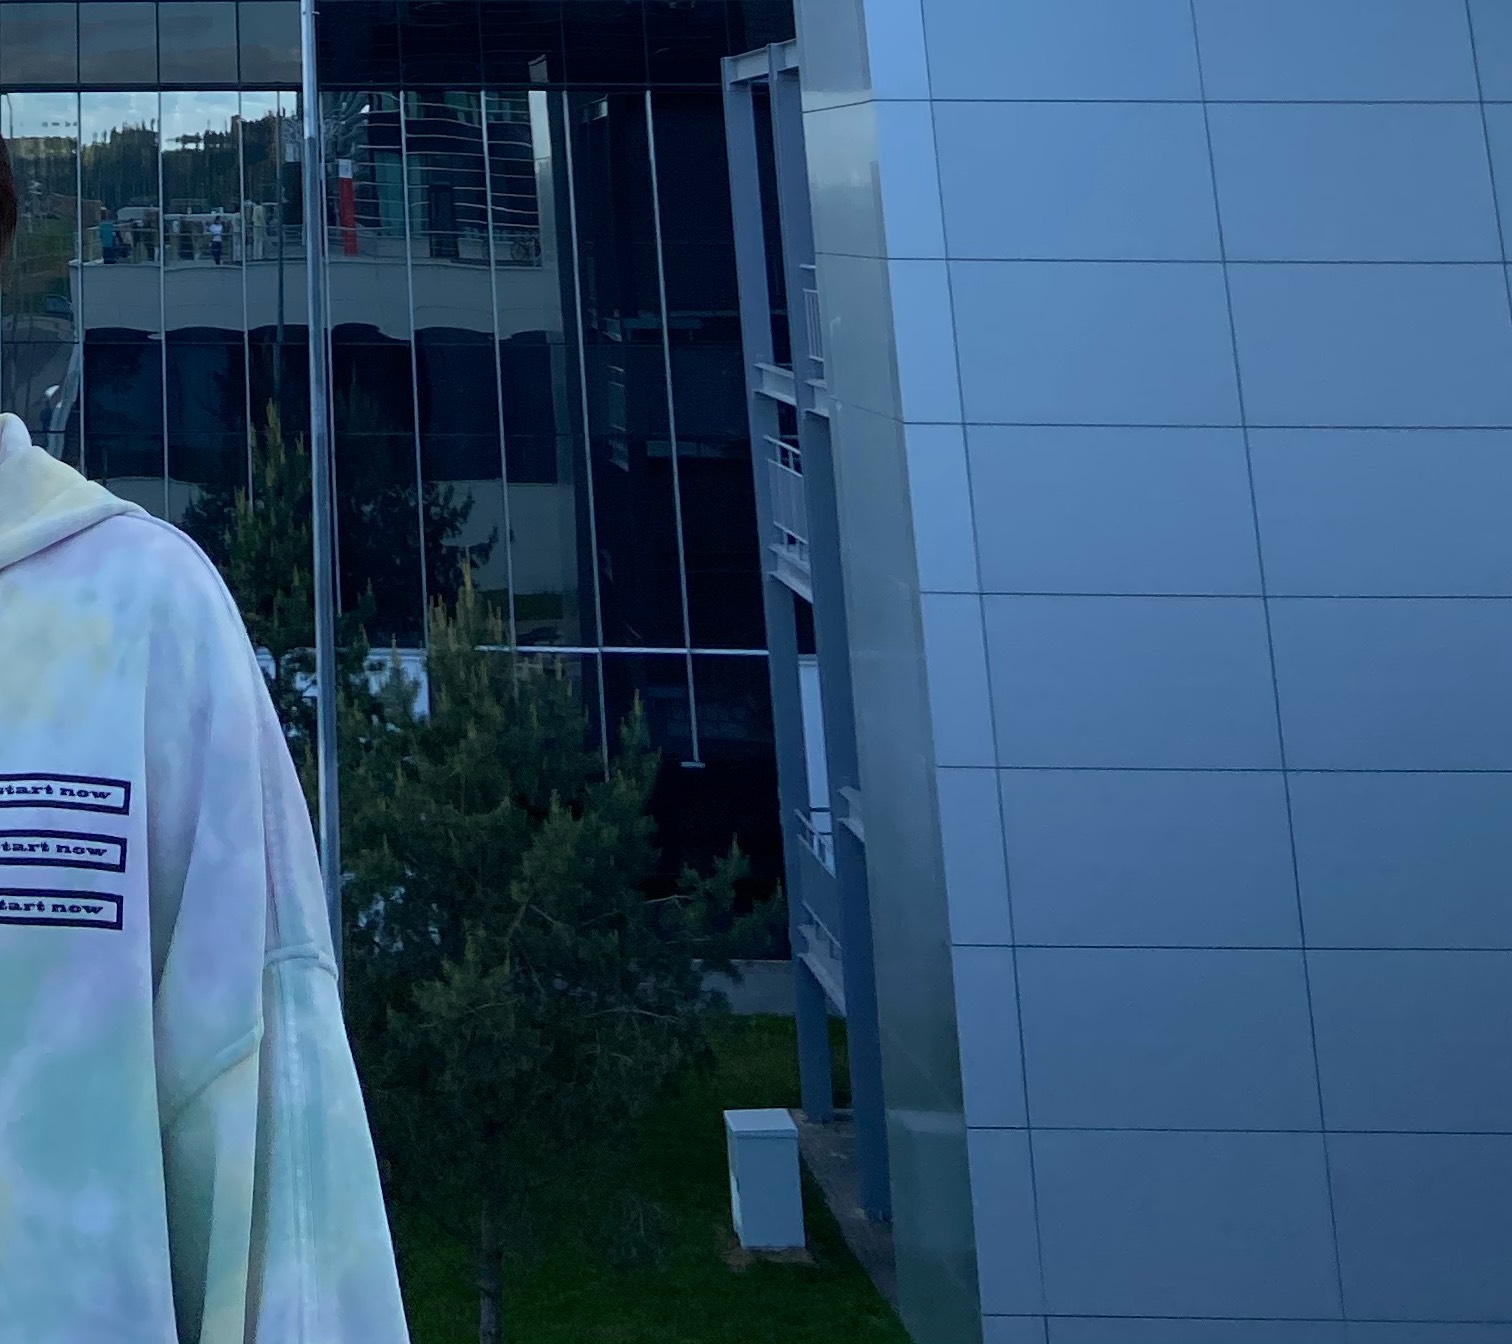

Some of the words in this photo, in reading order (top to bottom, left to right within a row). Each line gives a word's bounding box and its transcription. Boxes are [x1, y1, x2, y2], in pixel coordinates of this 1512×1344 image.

[59, 785, 113, 801] now
[55, 844, 109, 857] now
[50, 902, 104, 915] now
